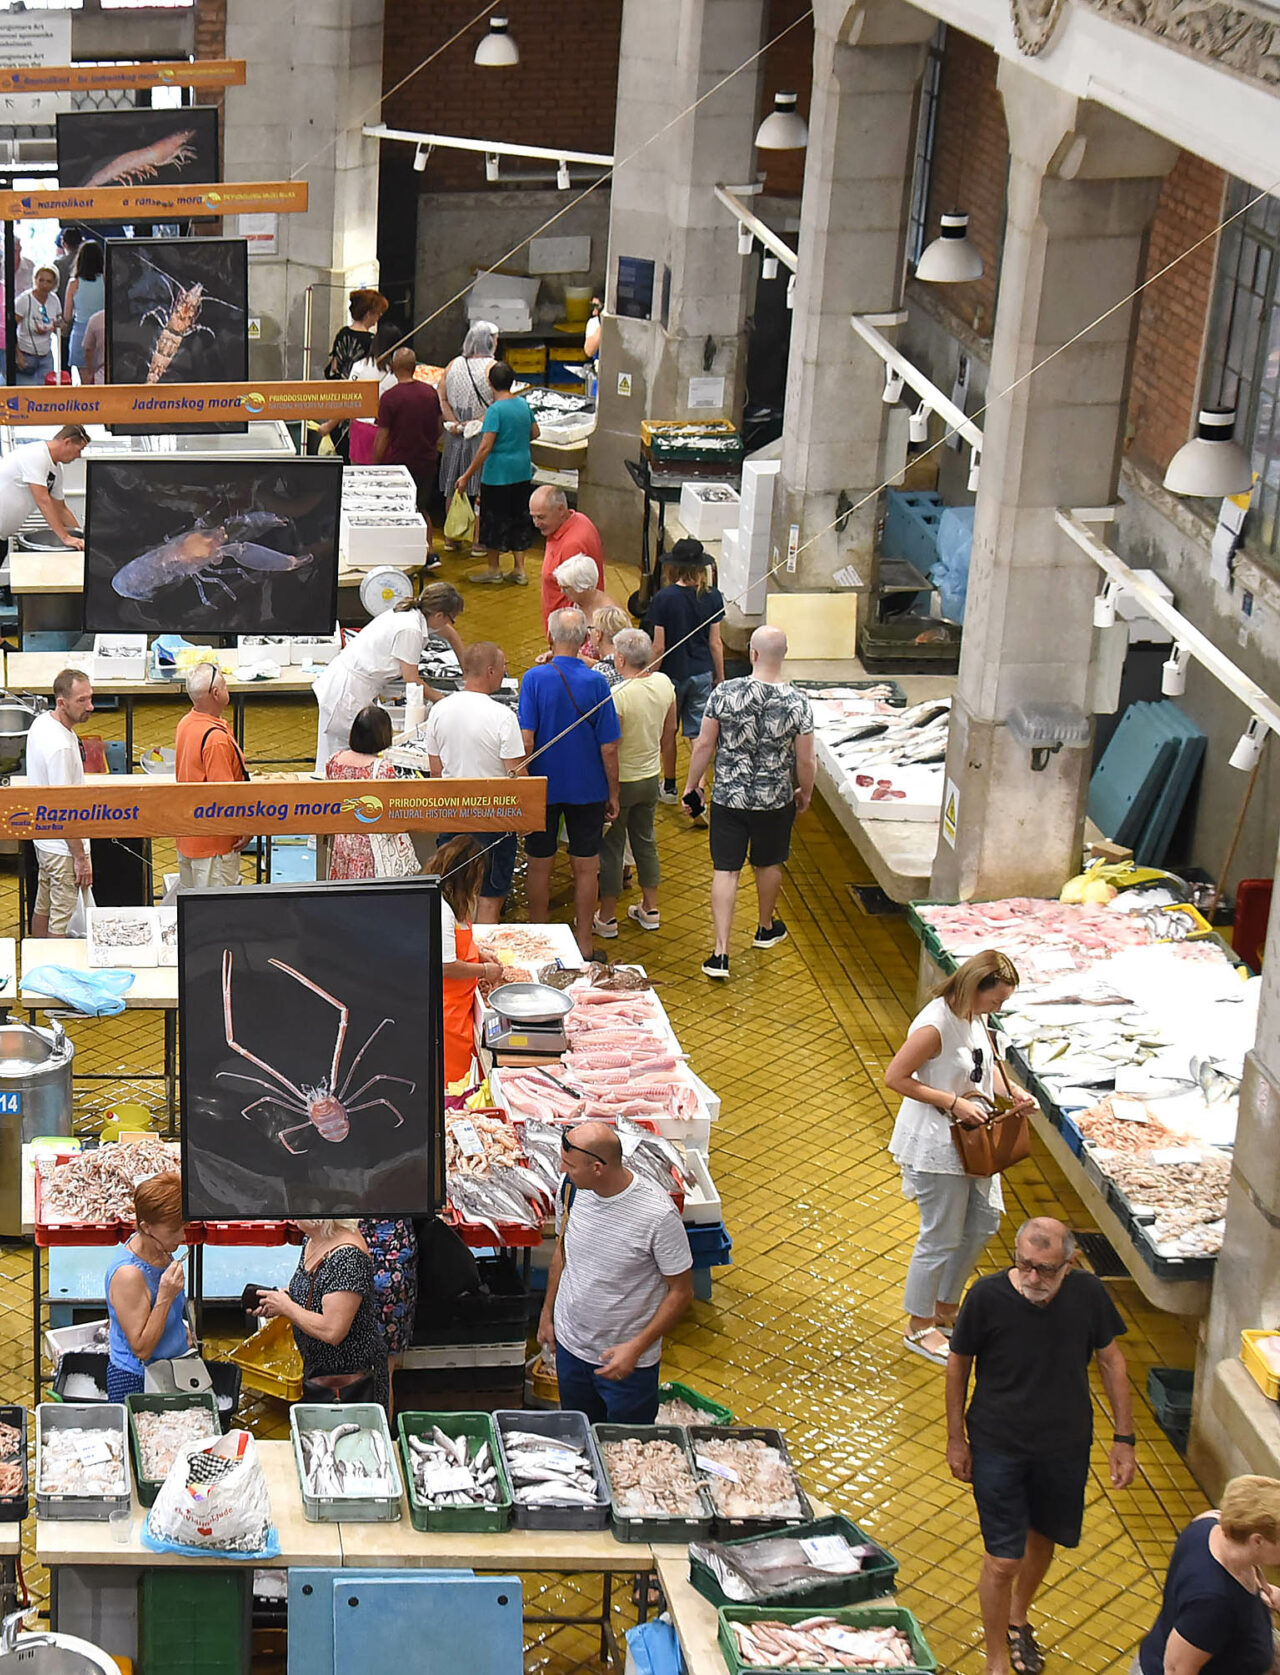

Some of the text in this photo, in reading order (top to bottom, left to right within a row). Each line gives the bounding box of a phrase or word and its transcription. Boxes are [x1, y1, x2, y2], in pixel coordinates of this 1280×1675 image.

[269, 392, 363, 403] PRIRODOSLOVNI MUZEJ RIJEKA
[27, 397, 242, 413] Raznolikost Jadranskog mora
[388, 798, 460, 808] PRIRODOSLOVNI
[462, 796, 491, 807] MUZEJ
[35, 801, 341, 822] Raznolikost adranskog mora
[388, 808, 424, 819] NATURAL
[425, 808, 457, 819] HISTORY
[496, 807, 523, 818] RIJEKA
[0, 1094, 18, 1112] 14
